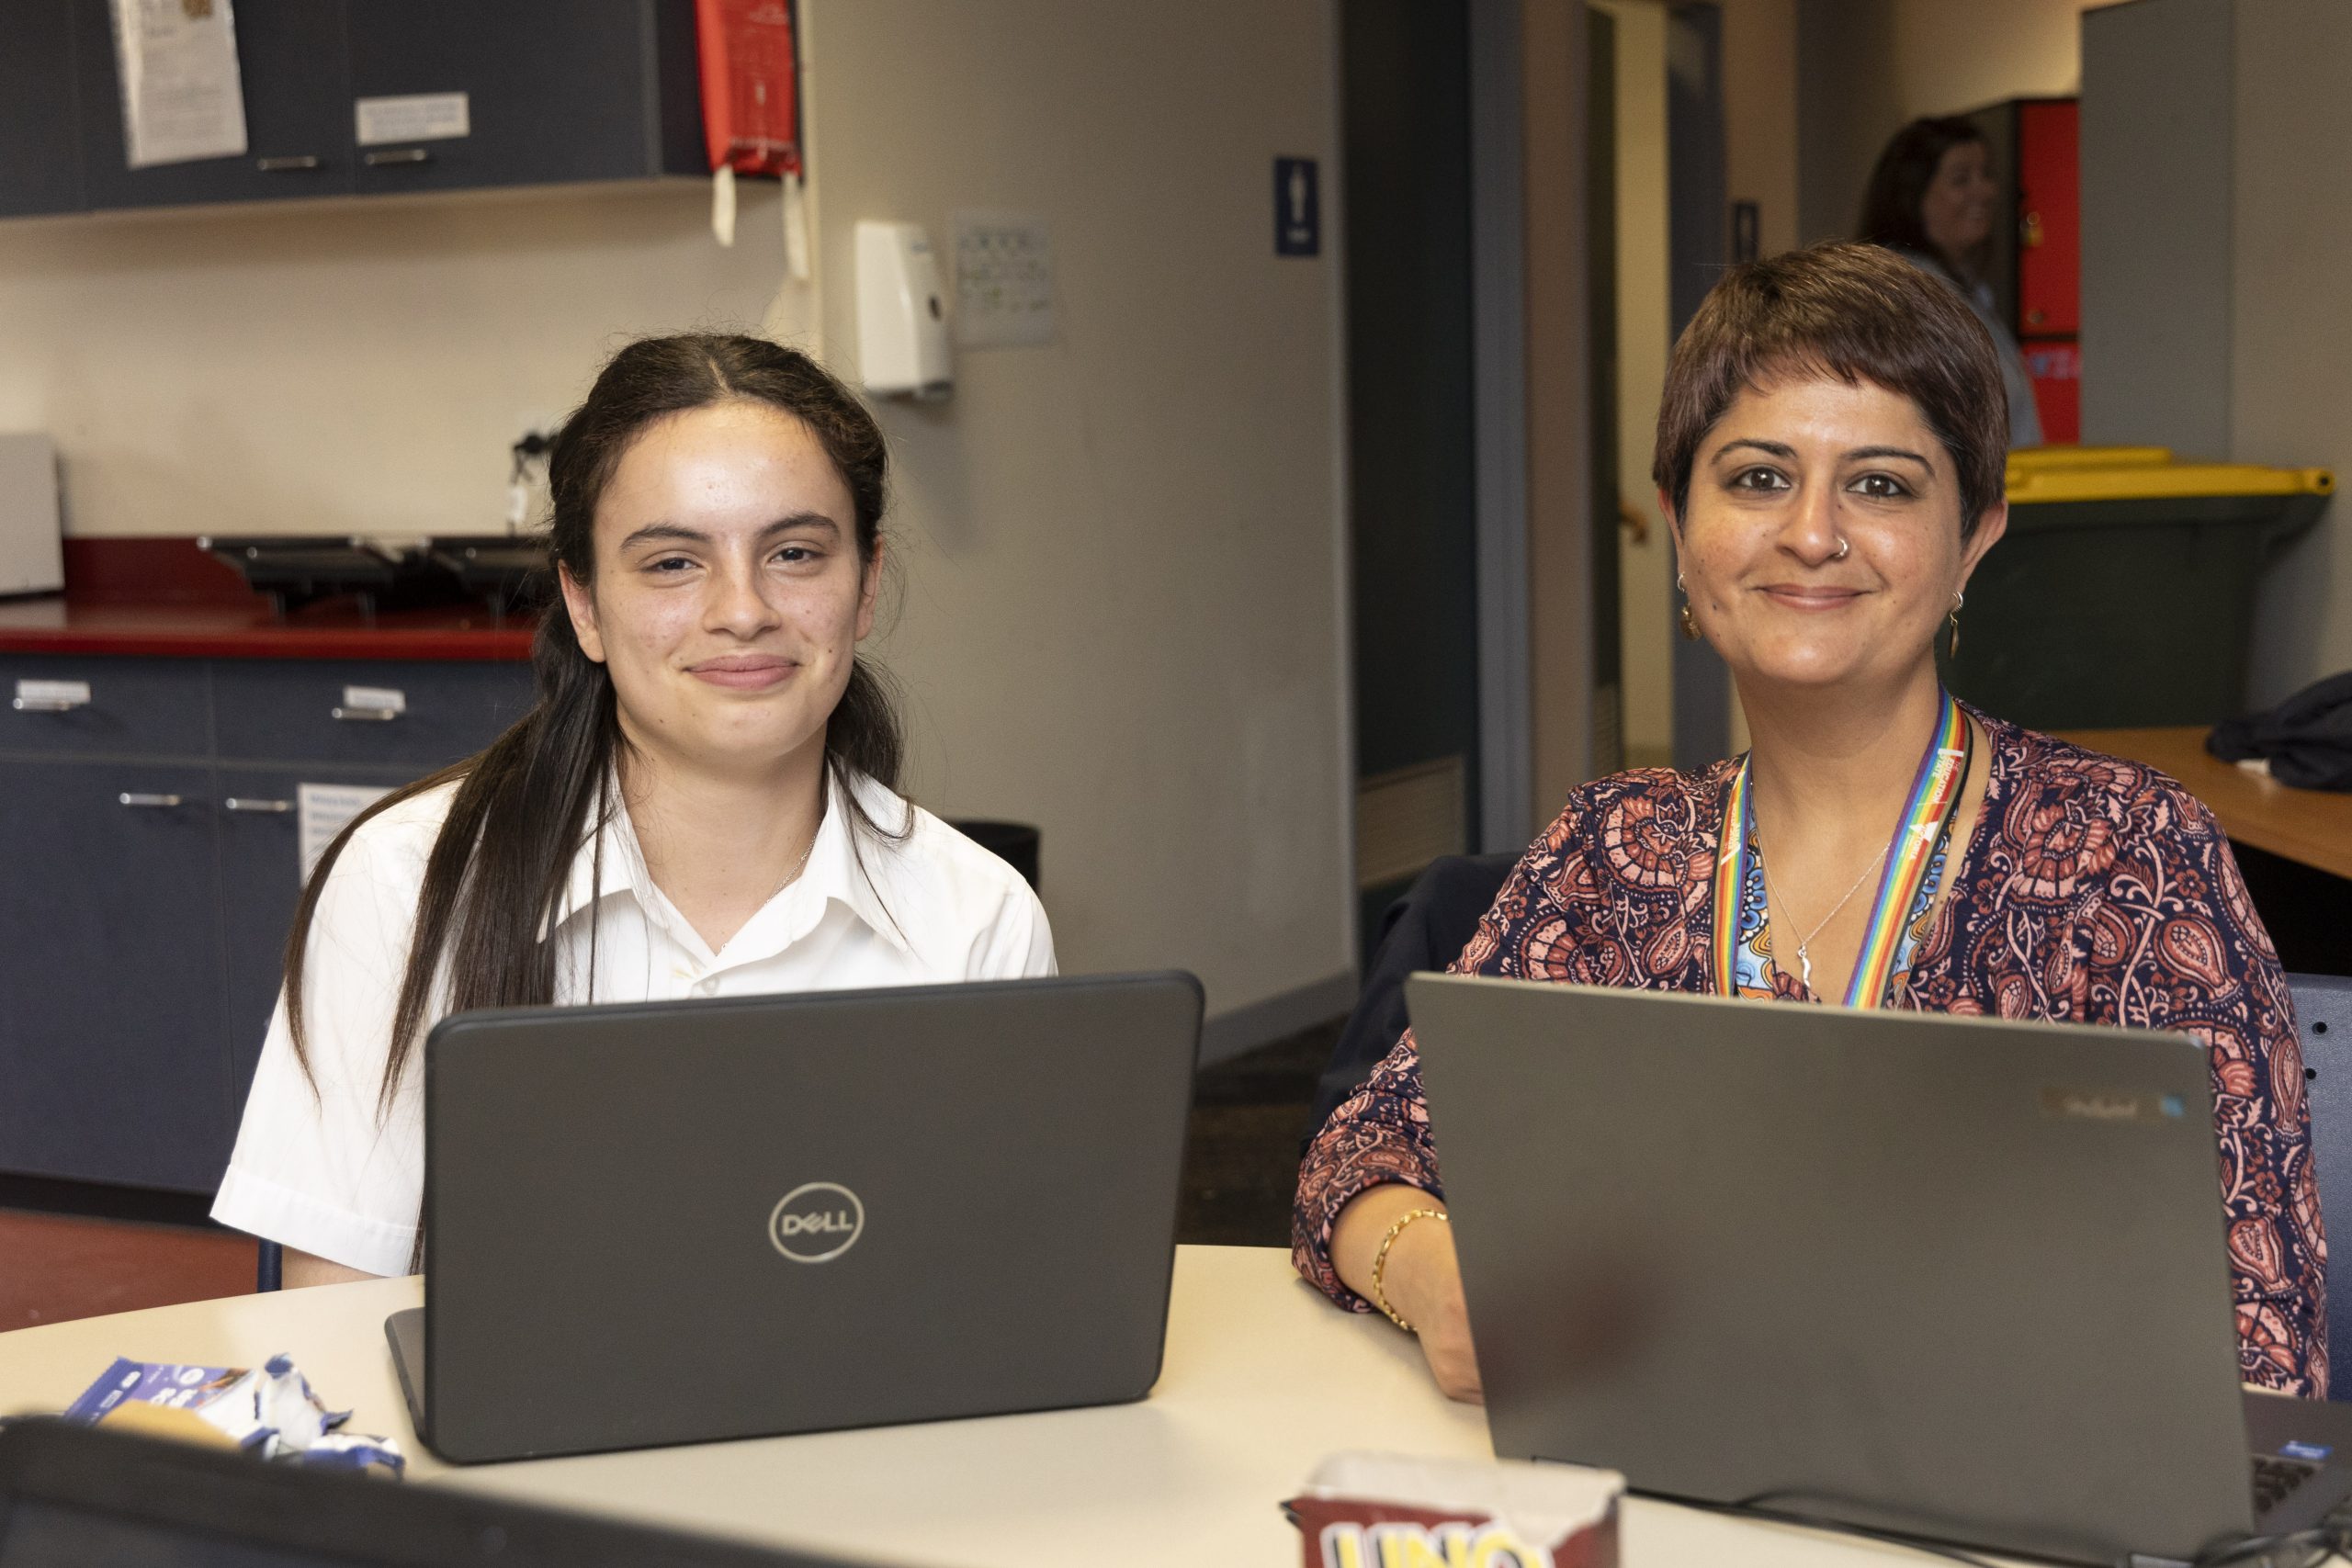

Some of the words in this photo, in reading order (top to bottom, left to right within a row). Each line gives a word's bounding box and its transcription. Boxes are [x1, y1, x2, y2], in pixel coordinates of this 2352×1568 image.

[1931, 754, 1947, 778] STATE
[1932, 758, 1955, 804] EDUCATION
[782, 1210, 854, 1236] DELL
